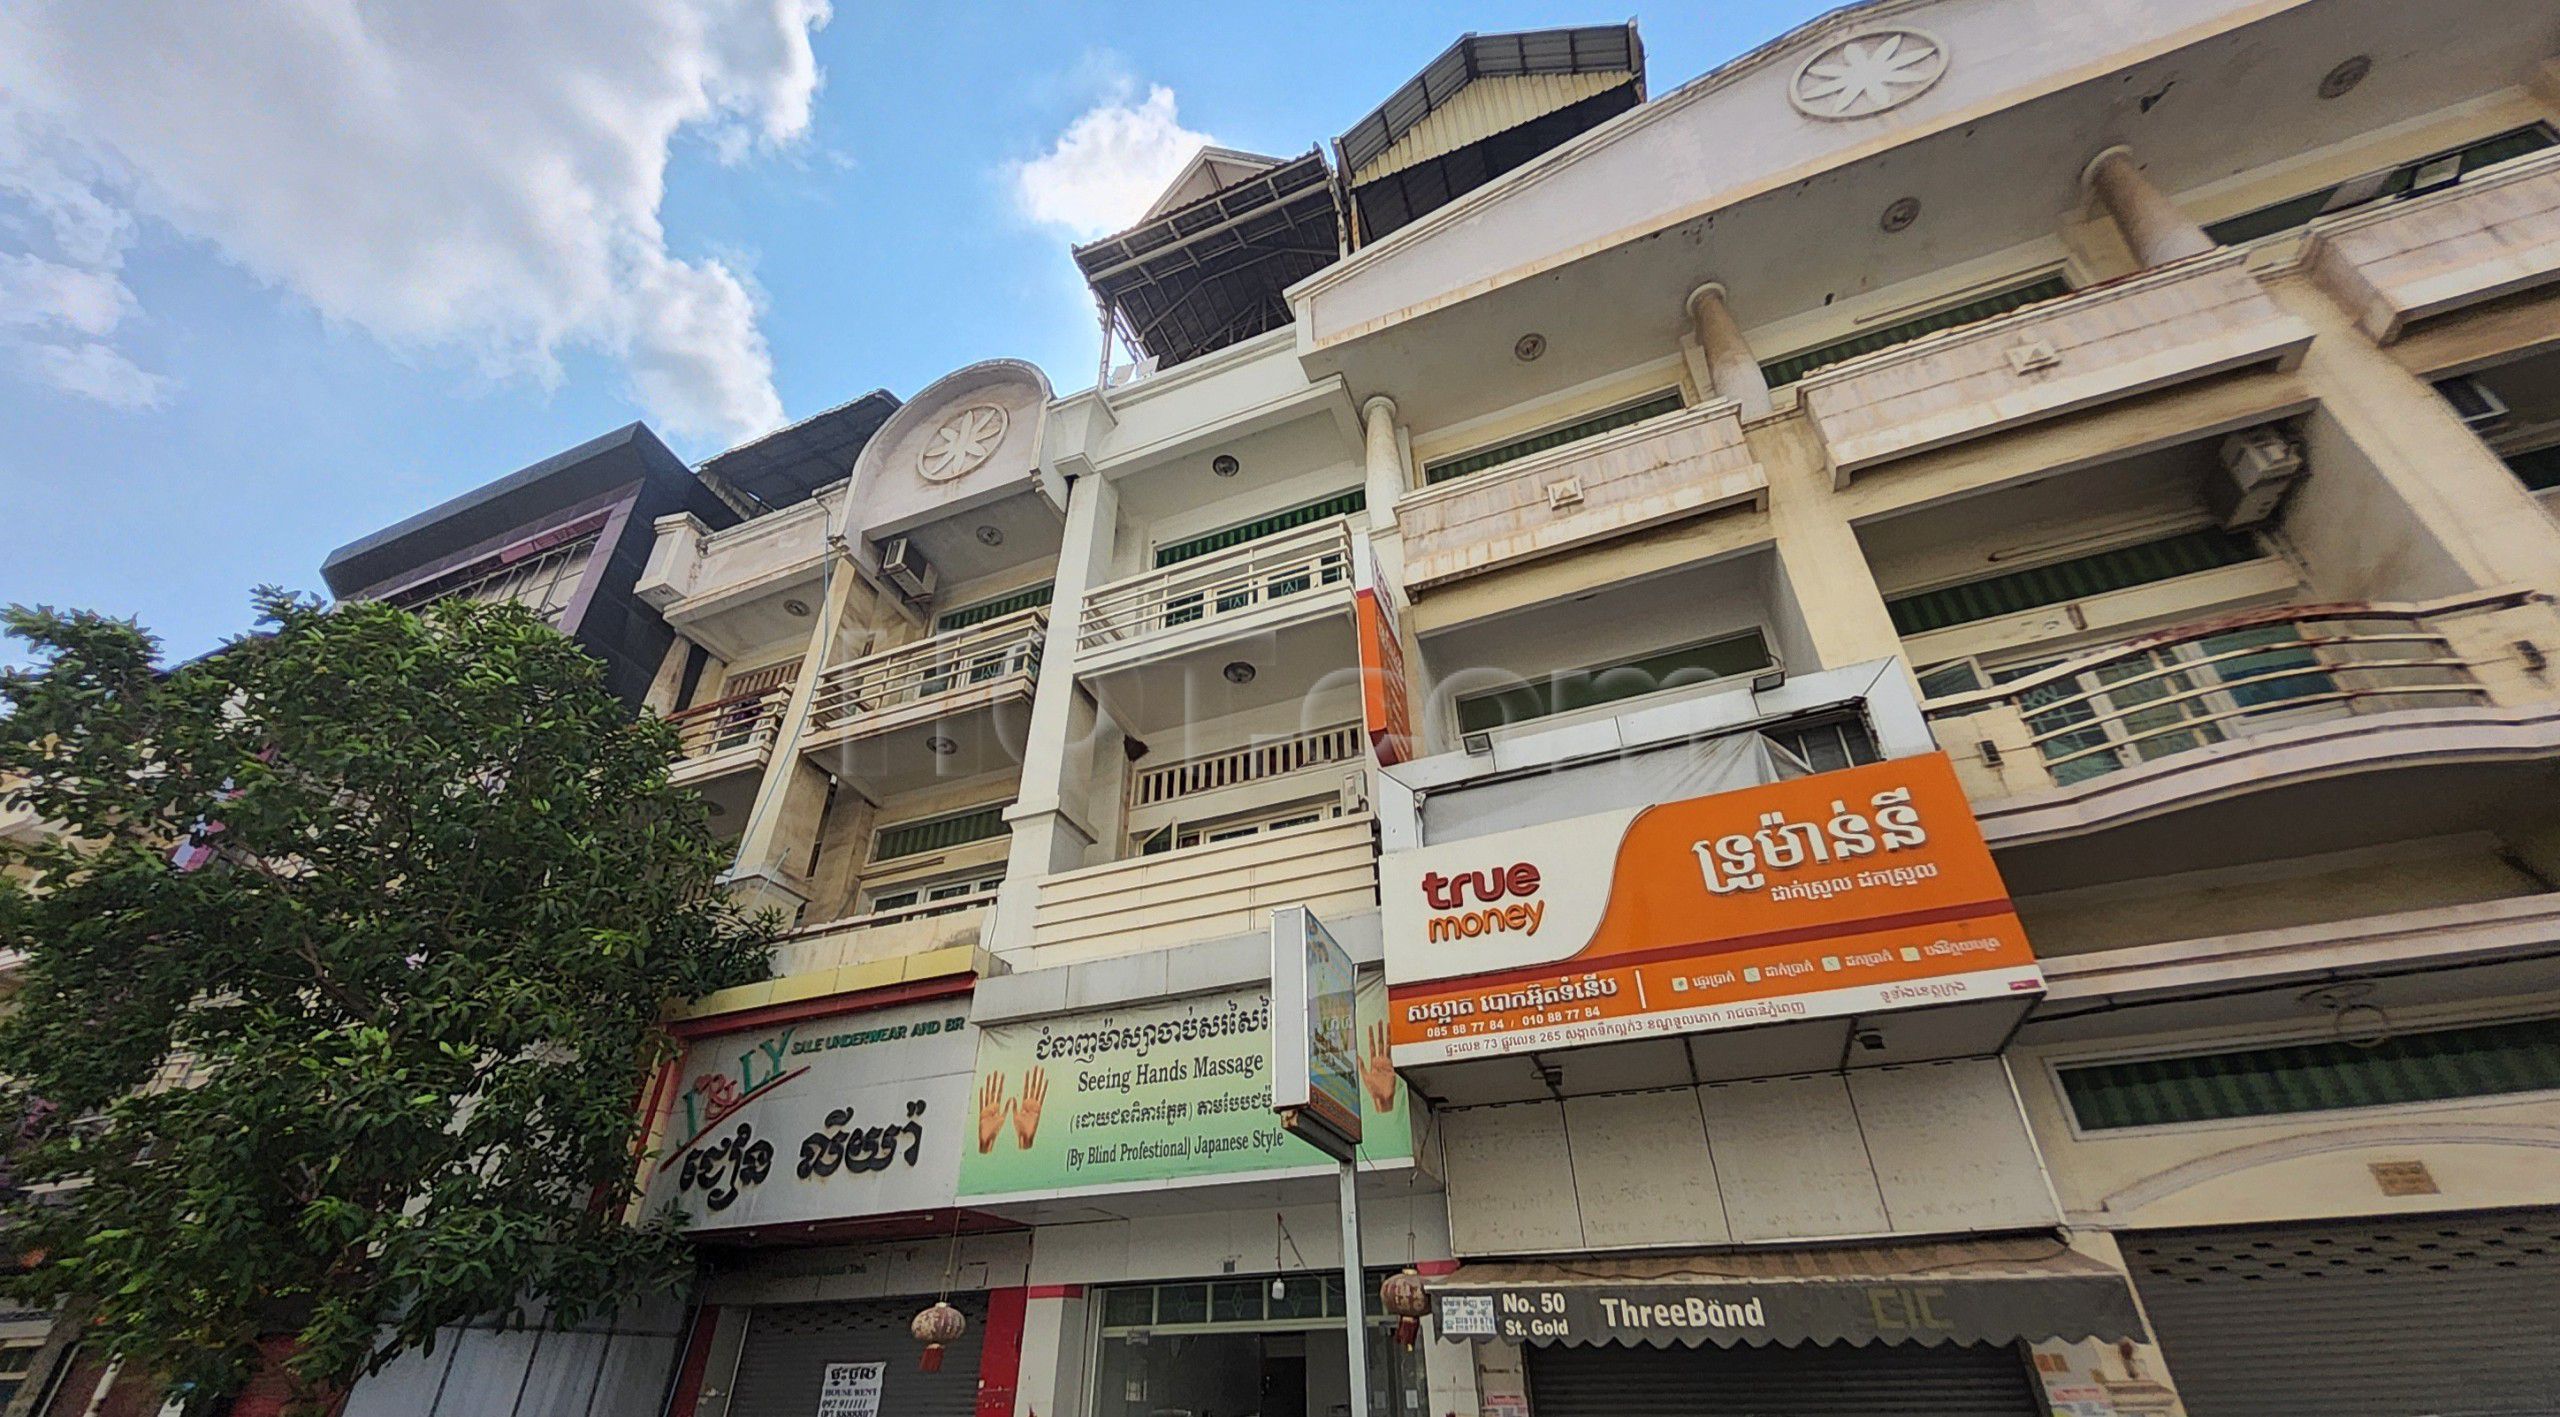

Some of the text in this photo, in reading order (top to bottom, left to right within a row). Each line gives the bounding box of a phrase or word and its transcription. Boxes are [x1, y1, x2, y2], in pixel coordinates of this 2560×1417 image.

[1421, 862, 1541, 909] true
[1770, 862, 1939, 902] ដាក់ស្រួល ដកស្រួល
[1428, 899, 1545, 943] money
[826, 1026, 907, 1050] UNDERWEAR
[911, 1020, 941, 1038] AND
[1426, 1026, 1447, 1038] 085
[1452, 1024, 1467, 1035] 88
[1470, 1022, 1485, 1033] 77
[1489, 1019, 1505, 1030] 84
[1521, 1014, 1544, 1027] 010
[1547, 1011, 1563, 1024] 88
[1565, 1009, 1581, 1021] 77
[1584, 1006, 1601, 1018] 84
[1483, 1038, 1499, 1050] 73
[1539, 1030, 1561, 1043] 265
[1077, 1054, 1264, 1094] Seeing Hands Massage
[1066, 1130, 1284, 1171] (By Blind Profestional) Japanese Style
[1502, 1293, 1566, 1313] No. 50
[1504, 1318, 1569, 1336] St. Gold
[825, 1388, 853, 1397] HOUSE
